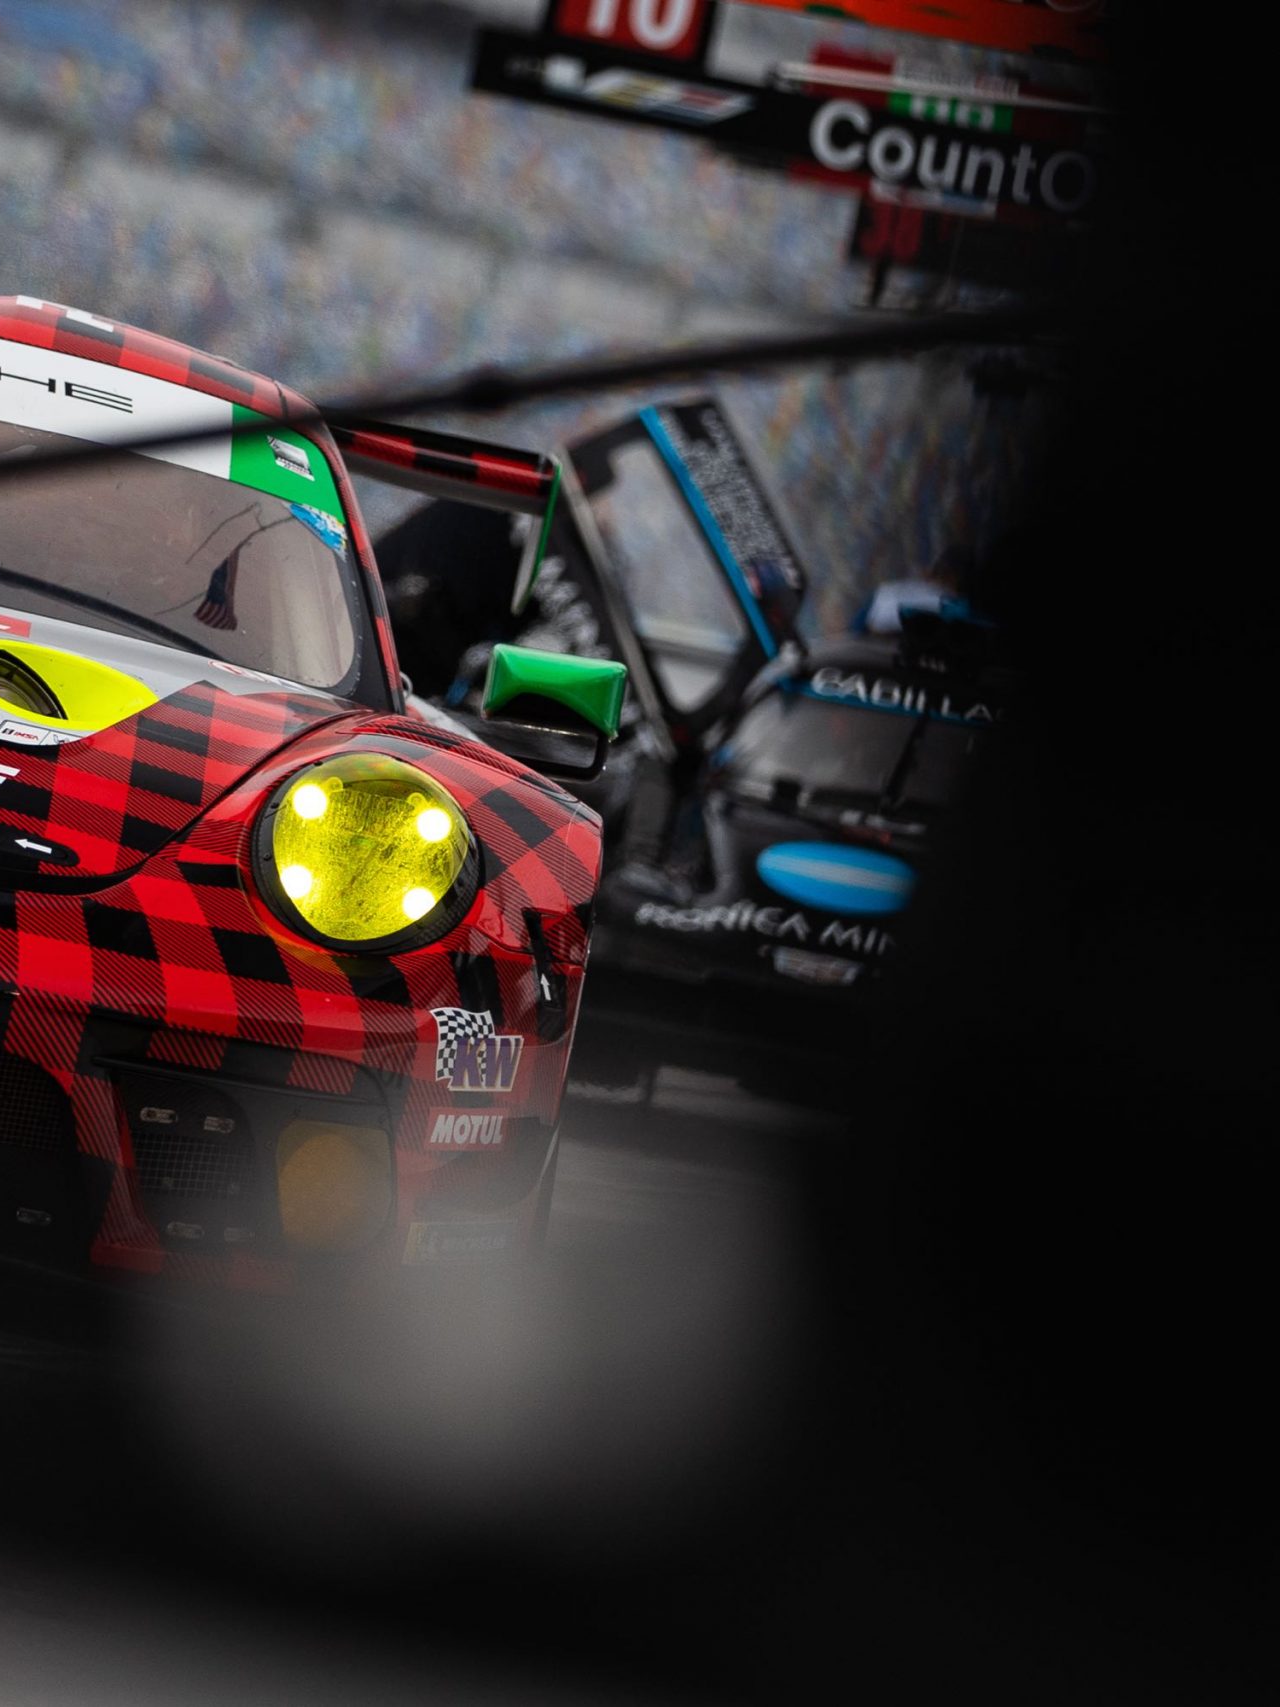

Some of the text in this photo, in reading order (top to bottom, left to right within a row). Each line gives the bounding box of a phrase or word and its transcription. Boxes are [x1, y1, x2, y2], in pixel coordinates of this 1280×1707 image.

[810, 667, 1004, 722] CADILLA
[450, 1035, 524, 1091] KW
[430, 1113, 503, 1145] MOTUL
